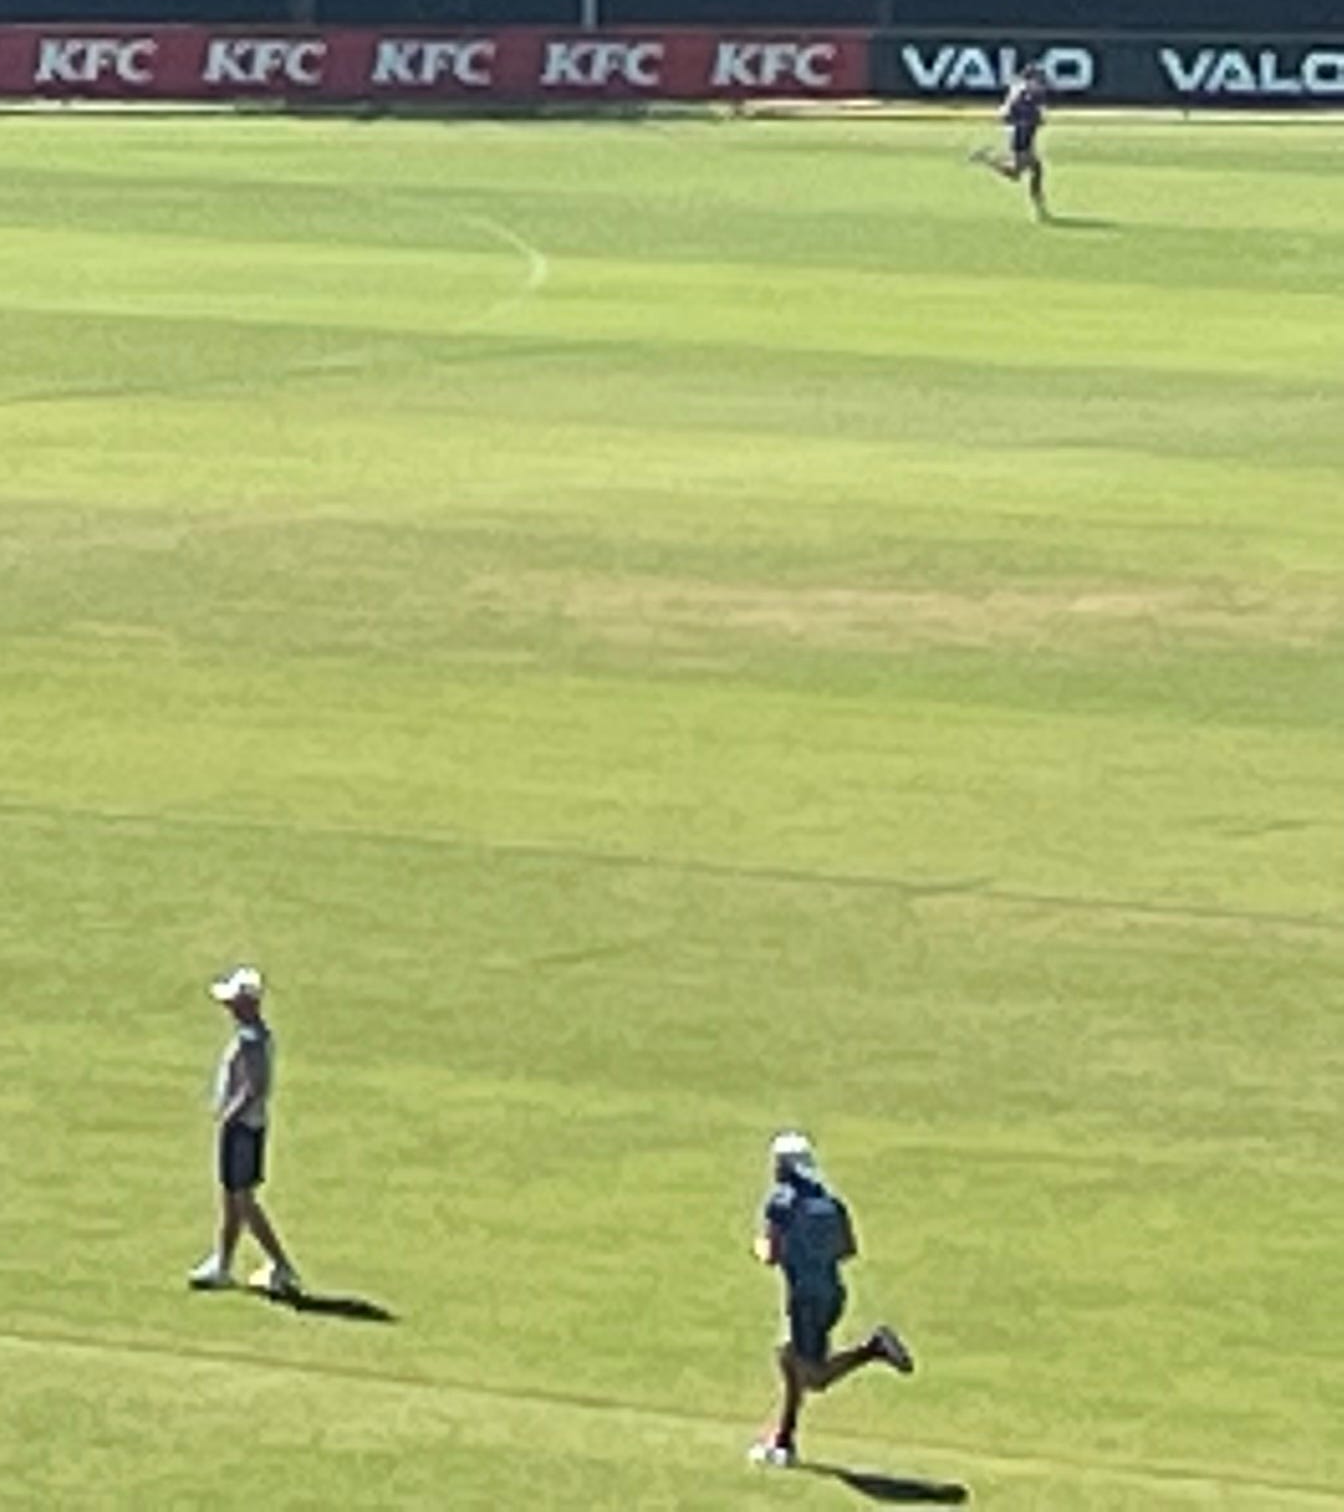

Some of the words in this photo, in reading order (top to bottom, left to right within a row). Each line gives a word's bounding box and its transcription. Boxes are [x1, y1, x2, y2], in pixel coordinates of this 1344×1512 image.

[35, 40, 157, 82] KFC
[204, 40, 326, 83] KFC
[372, 42, 494, 84] KFC
[541, 43, 663, 85] KFC
[713, 44, 835, 85] KFC
[902, 45, 1093, 90] VALO
[1160, 48, 1344, 92] VALO
